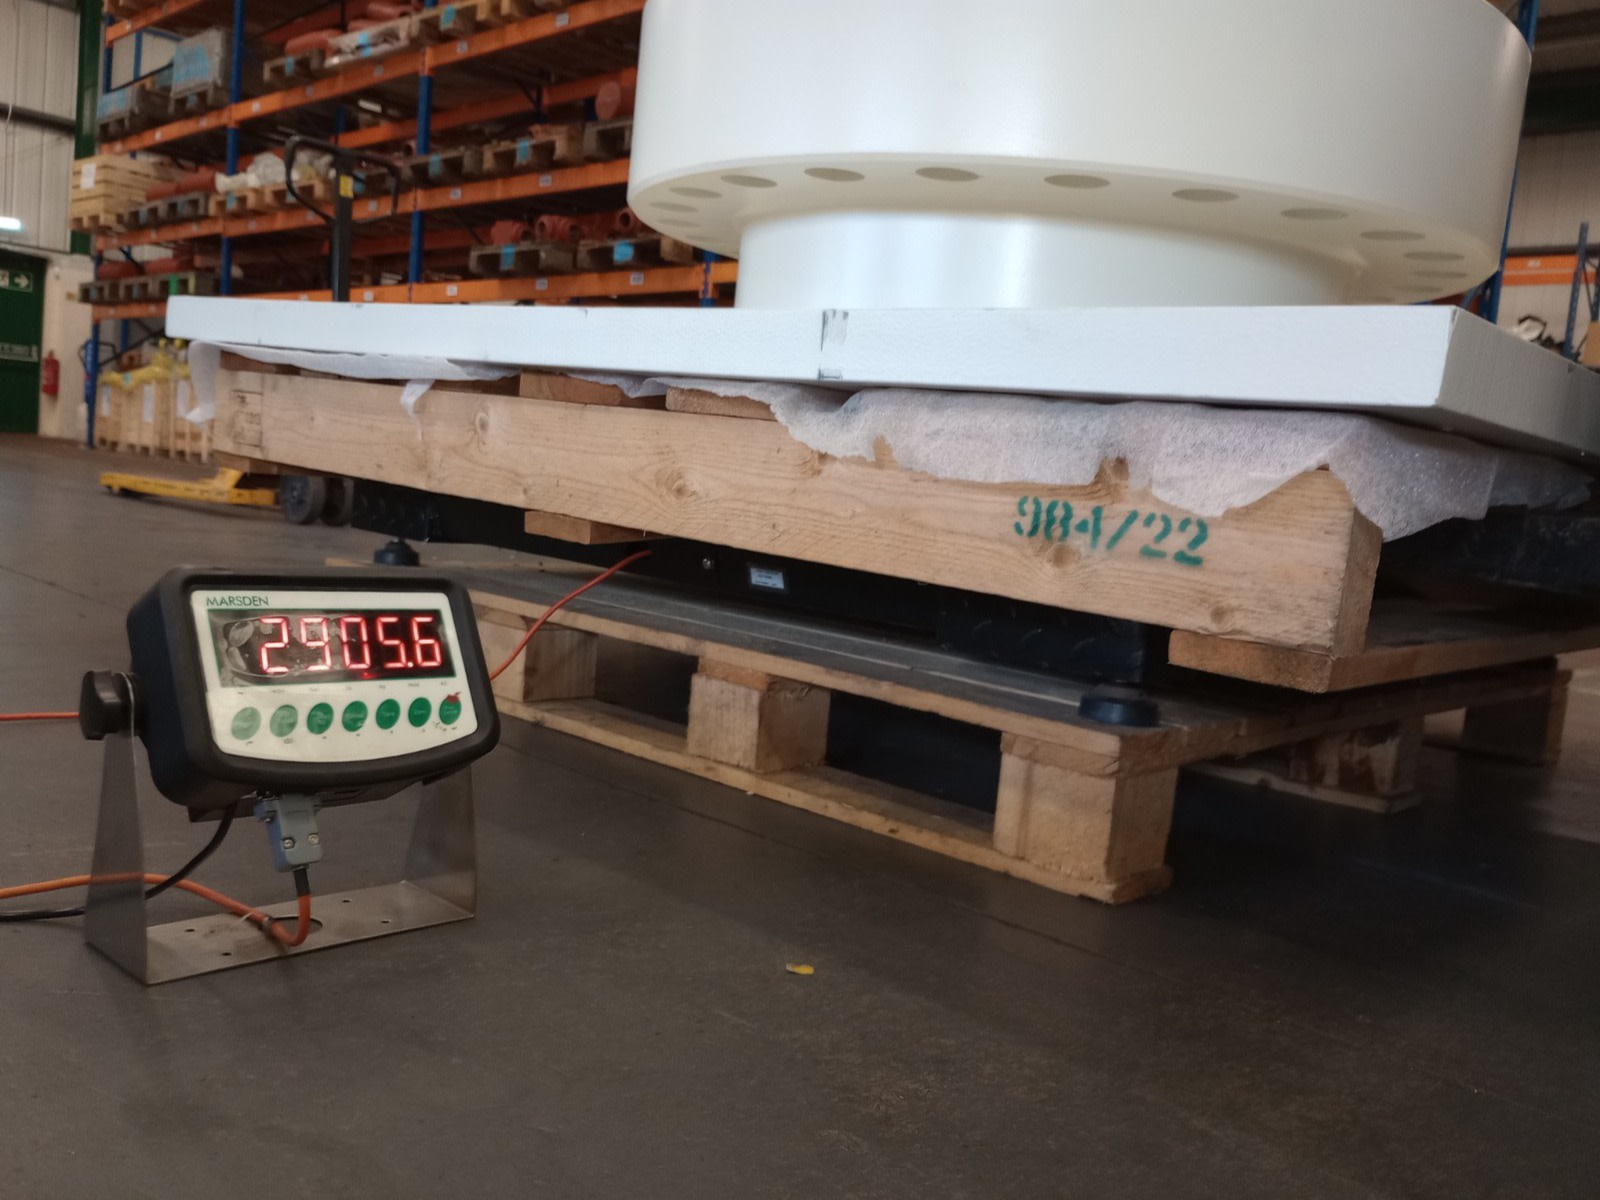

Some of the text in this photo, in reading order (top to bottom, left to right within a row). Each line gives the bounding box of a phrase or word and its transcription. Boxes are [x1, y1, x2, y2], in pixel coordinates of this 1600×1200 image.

[1014, 496, 1208, 566] 984/22
[206, 595, 269, 607] MARSDEN
[258, 615, 442, 674] 2905.6
